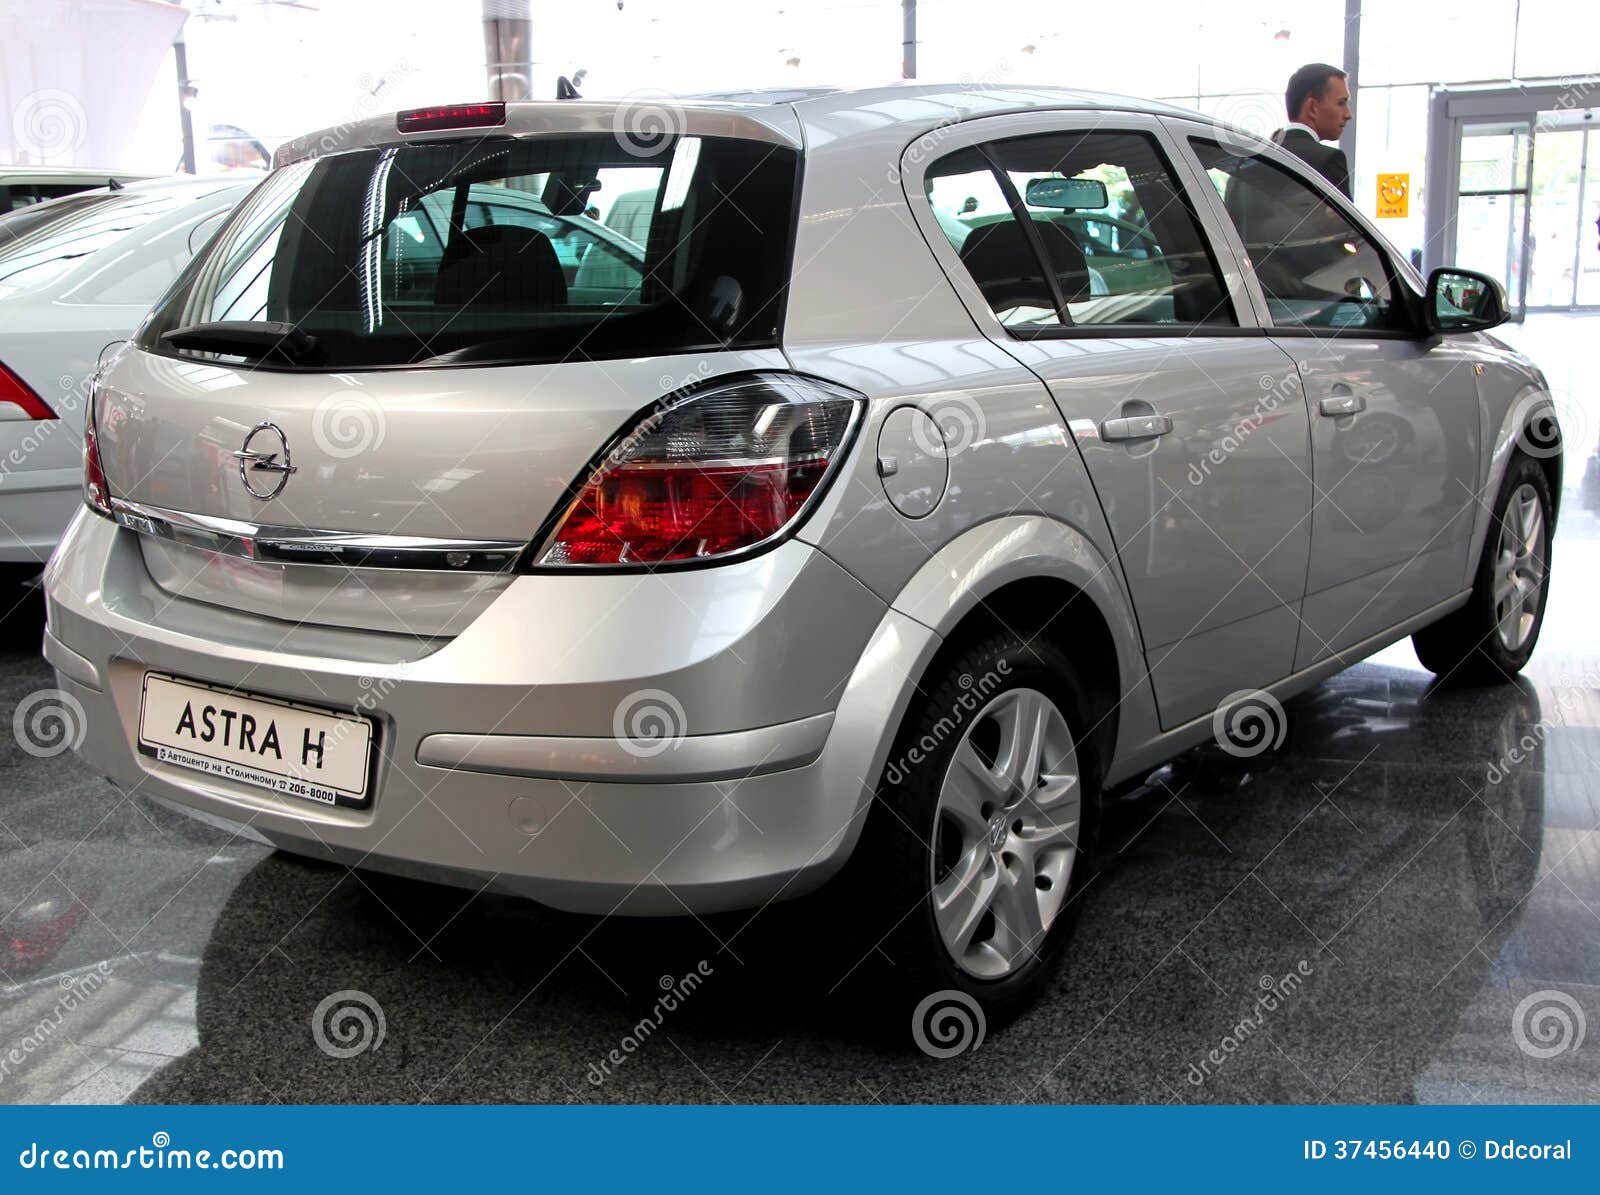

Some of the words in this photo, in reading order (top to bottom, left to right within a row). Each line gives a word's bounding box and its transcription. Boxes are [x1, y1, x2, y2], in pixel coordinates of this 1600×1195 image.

[176, 700, 282, 760] ASTRA
[301, 727, 326, 769] H
[167, 750, 210, 770] Автоцентр
[212, 763, 222, 773] на
[225, 766, 277, 788] Столичному
[289, 782, 334, 802] 206-8000
